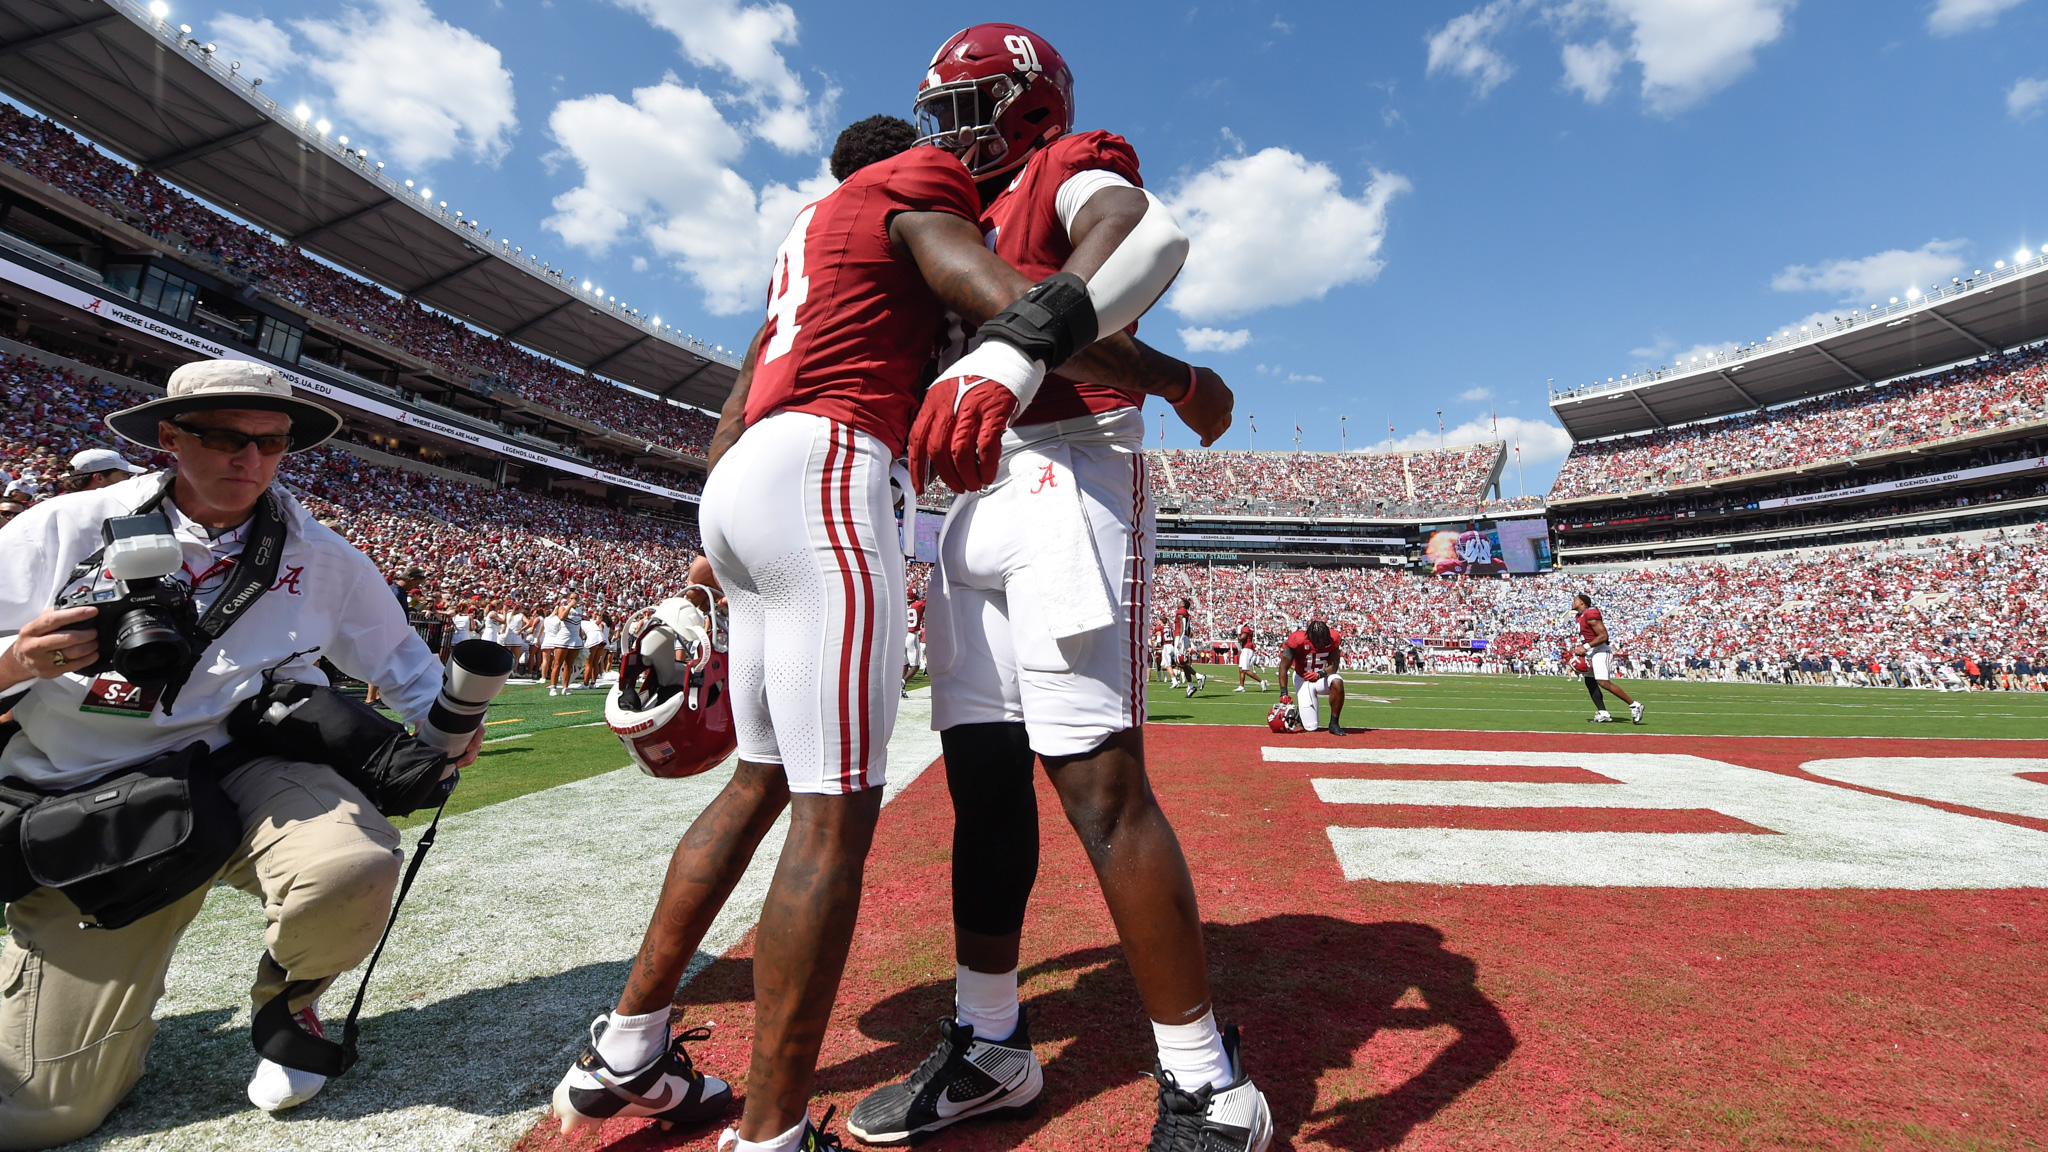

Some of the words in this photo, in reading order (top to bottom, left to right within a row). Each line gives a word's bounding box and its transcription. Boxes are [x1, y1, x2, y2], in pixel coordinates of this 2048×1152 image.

[1002, 34, 1043, 72] 91
[764, 205, 817, 366] 4
[112, 308, 143, 327] WHERE
[144, 321, 183, 341] LEGENDS
[183, 337, 201, 349] ARE
[201, 342, 226, 357] MADE
[279, 371, 332, 395] ENDS.UA.EDU
[412, 416, 432, 428] WHERE
[431, 422, 455, 435] LEGENDS
[454, 429, 466, 439] ARE
[465, 433, 481, 443] MADE
[502, 444, 549, 464] LEGENDS.UA.EDU
[603, 474, 617, 483] WHERE
[616, 477, 633, 487] LEGENDS
[667, 490, 700, 502] LEGENDS.UA.ED
[1895, 473, 1959, 489] LEGENDS.UA.EDU
[1795, 495, 1814, 503] WHERE
[1814, 492, 1838, 501] LEGENDS
[1849, 487, 1867, 495] MADE
[1162, 552, 1208, 560] BRYANT-DENNY
[130, 594, 156, 603] Canon
[222, 581, 262, 615] Canon
[1304, 652, 1330, 672] 15
[104, 683, 142, 702] S-A
